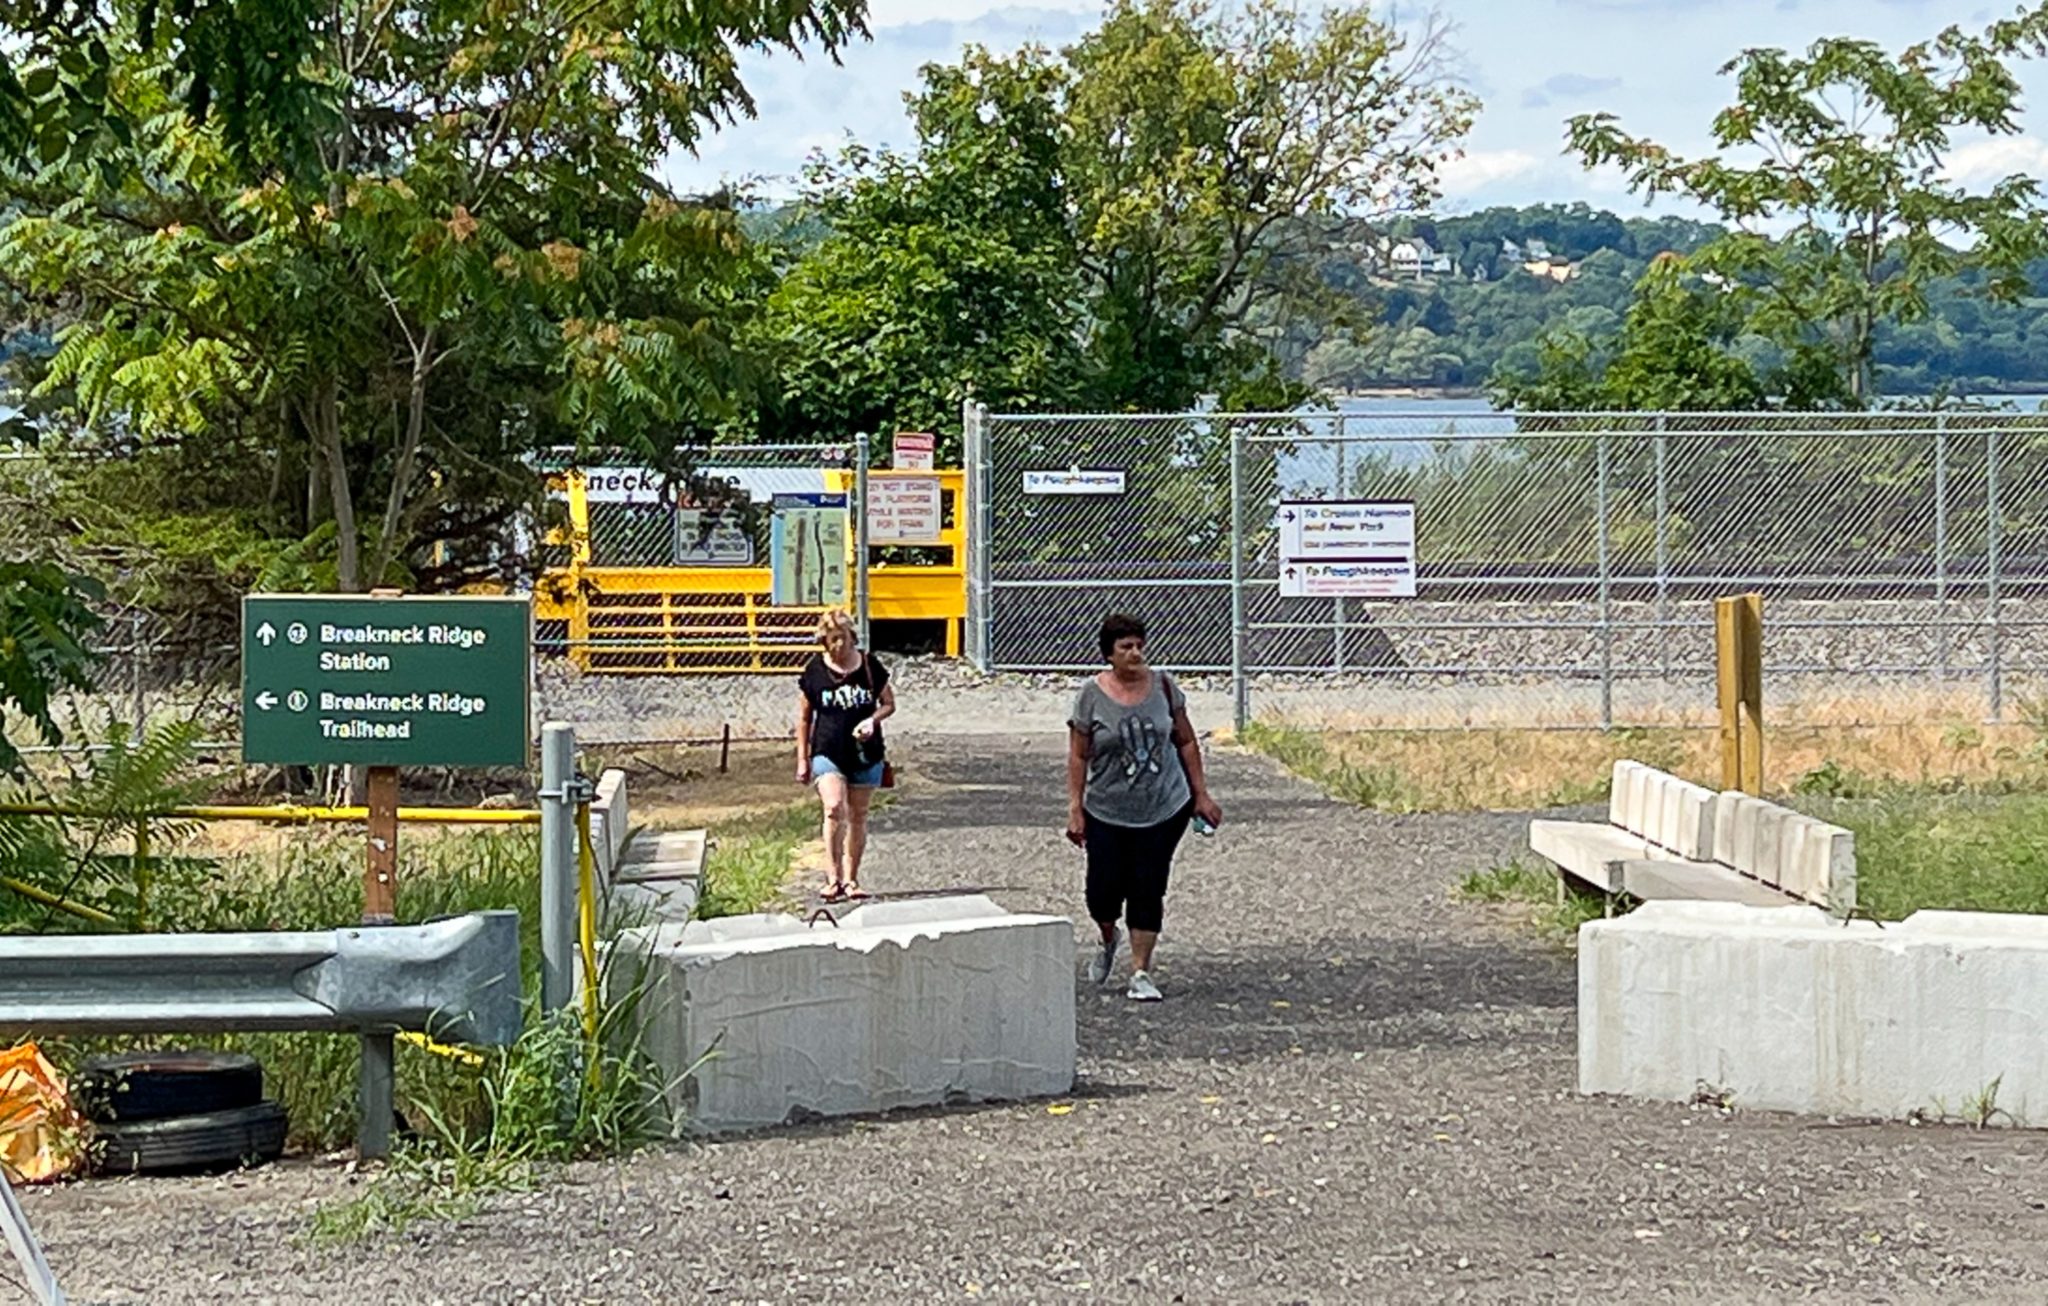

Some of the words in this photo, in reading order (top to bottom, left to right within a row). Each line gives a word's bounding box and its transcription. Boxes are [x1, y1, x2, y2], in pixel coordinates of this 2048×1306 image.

[1304, 509, 1318, 517] To
[320, 624, 424, 643] Breakneck
[428, 624, 486, 648] Ridge
[319, 652, 390, 671] Station
[320, 692, 424, 712] Breakneck
[428, 693, 486, 716] Ridge
[319, 720, 410, 739] Trailhead
